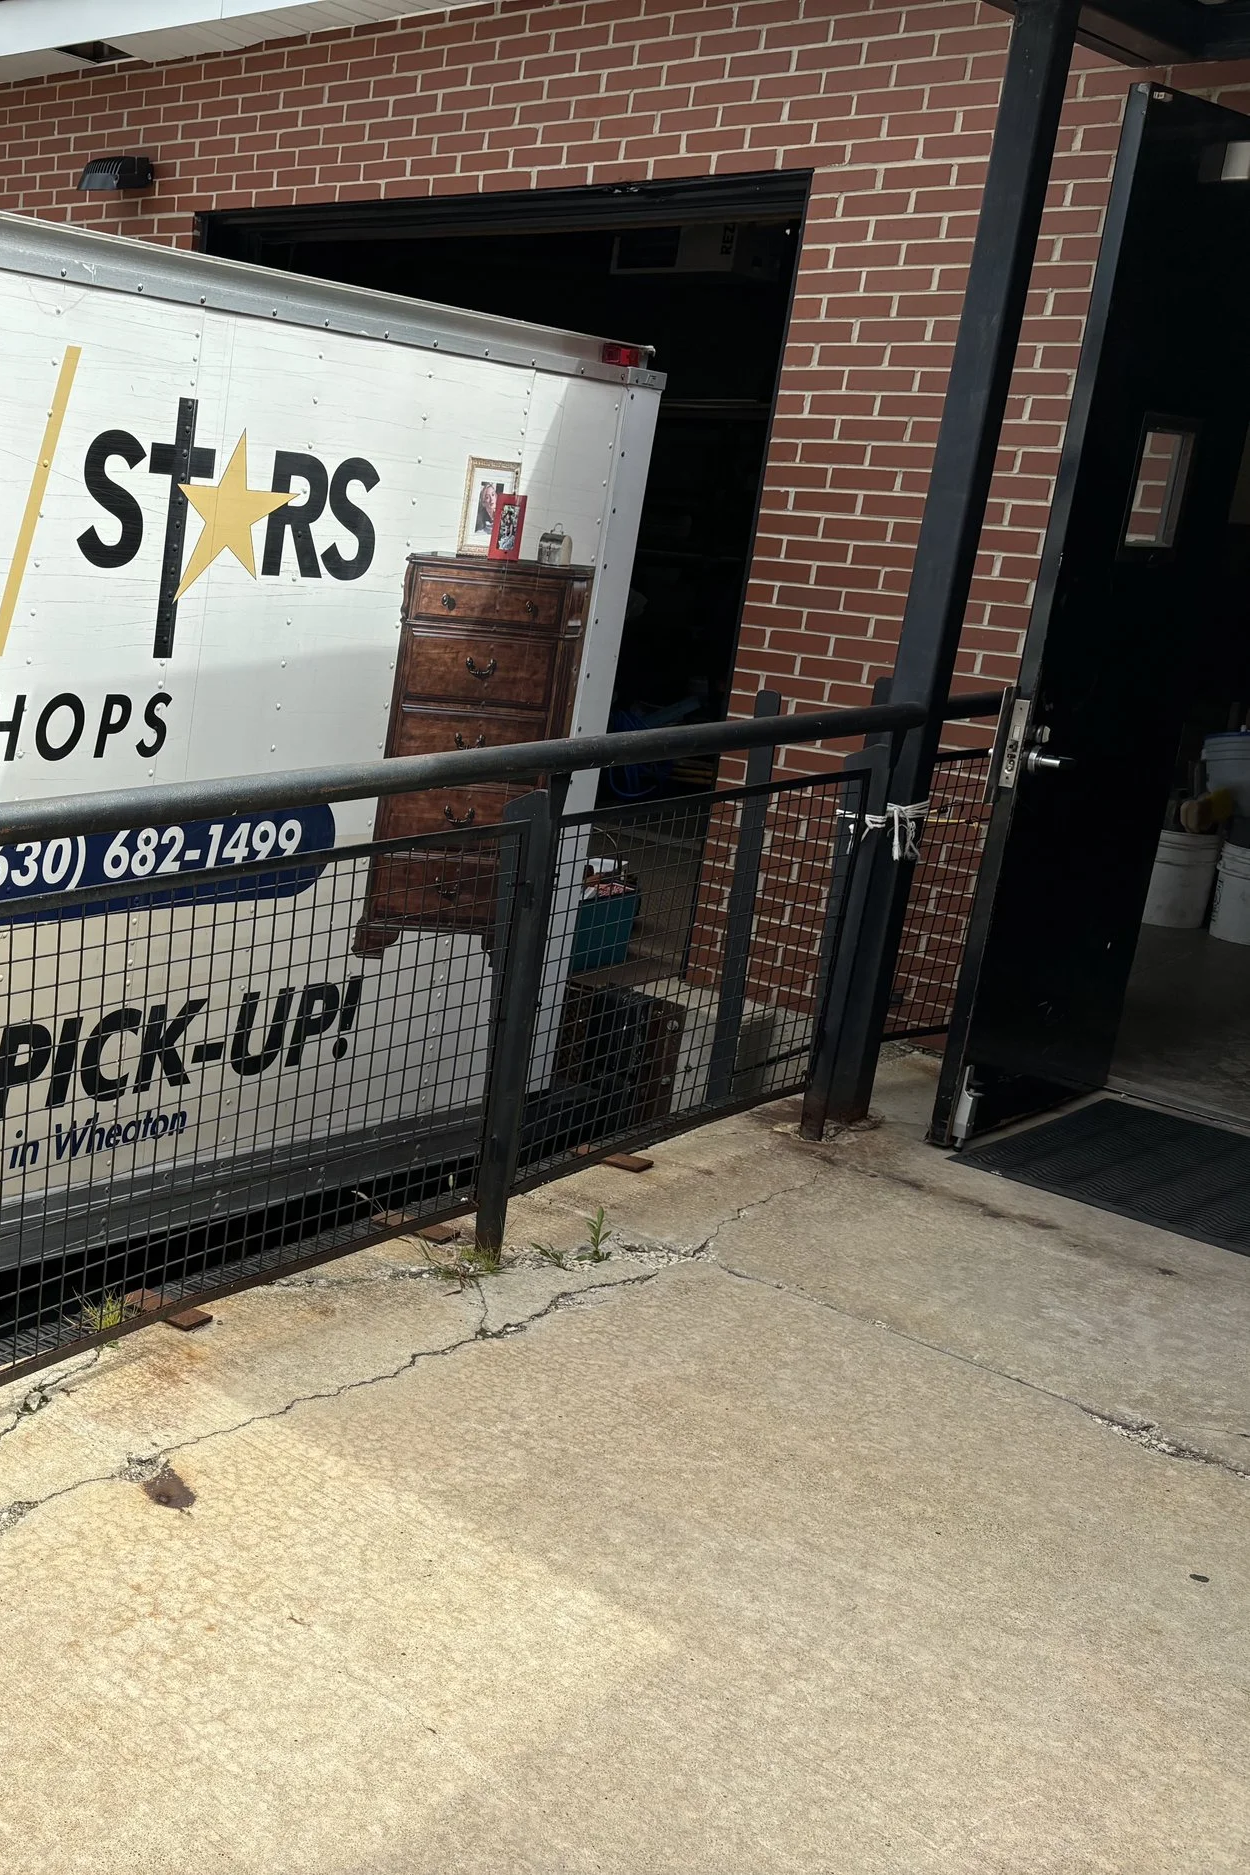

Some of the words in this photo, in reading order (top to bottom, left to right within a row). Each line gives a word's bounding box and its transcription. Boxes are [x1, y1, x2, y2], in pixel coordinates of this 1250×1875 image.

[102, 819, 303, 880] 682-1499
[9, 1129, 40, 1170] in
[55, 1110, 188, 1161] Wheaton
